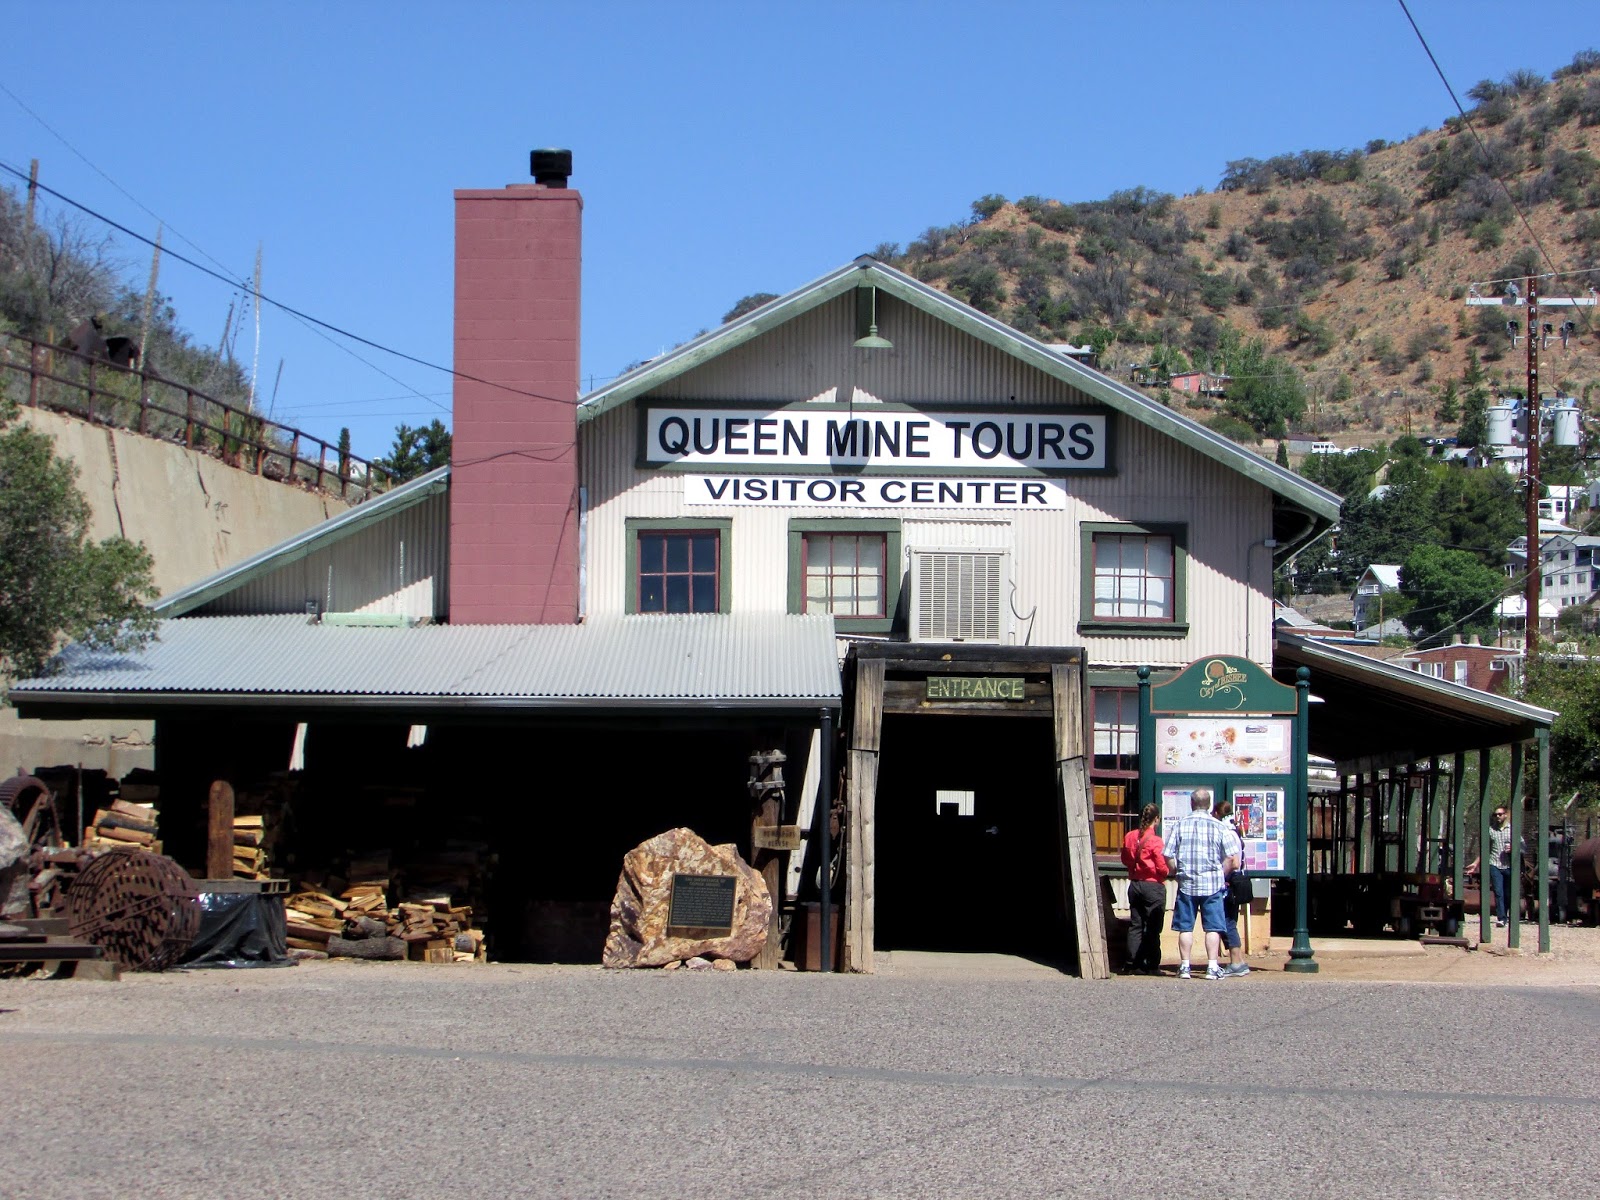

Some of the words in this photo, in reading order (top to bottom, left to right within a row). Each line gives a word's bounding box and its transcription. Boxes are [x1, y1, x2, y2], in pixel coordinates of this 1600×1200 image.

[658, 416, 809, 457] QUEEN
[826, 419, 931, 458] MINE
[945, 421, 1095, 461] TOURS
[703, 478, 867, 503] VISITOR
[880, 480, 1048, 505] CENTER
[928, 679, 1024, 698] ENTRANCE
